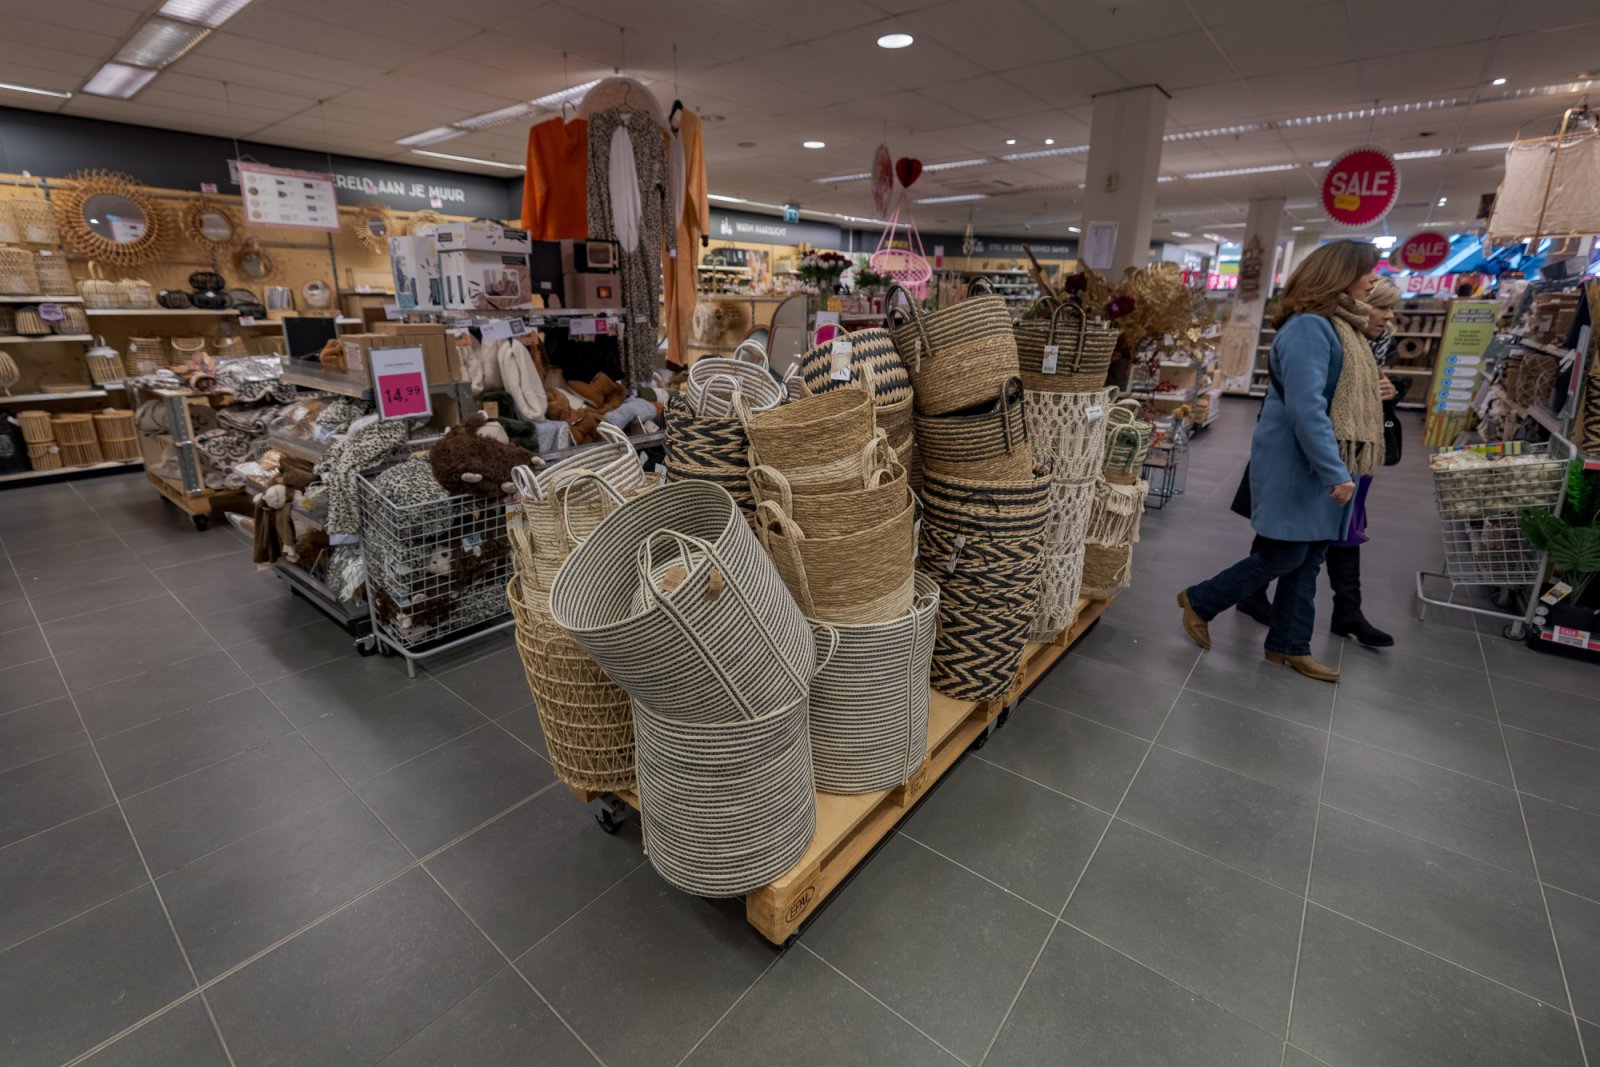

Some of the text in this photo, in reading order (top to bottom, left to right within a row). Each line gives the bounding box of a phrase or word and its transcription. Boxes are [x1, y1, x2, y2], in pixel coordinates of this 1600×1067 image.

[378, 180, 405, 195] AAN
[409, 184, 425, 197] JE
[428, 186, 465, 202] MUUR
[1329, 170, 1391, 196] SALE
[1406, 242, 1445, 256] SALE
[384, 385, 421, 403] 14.99
